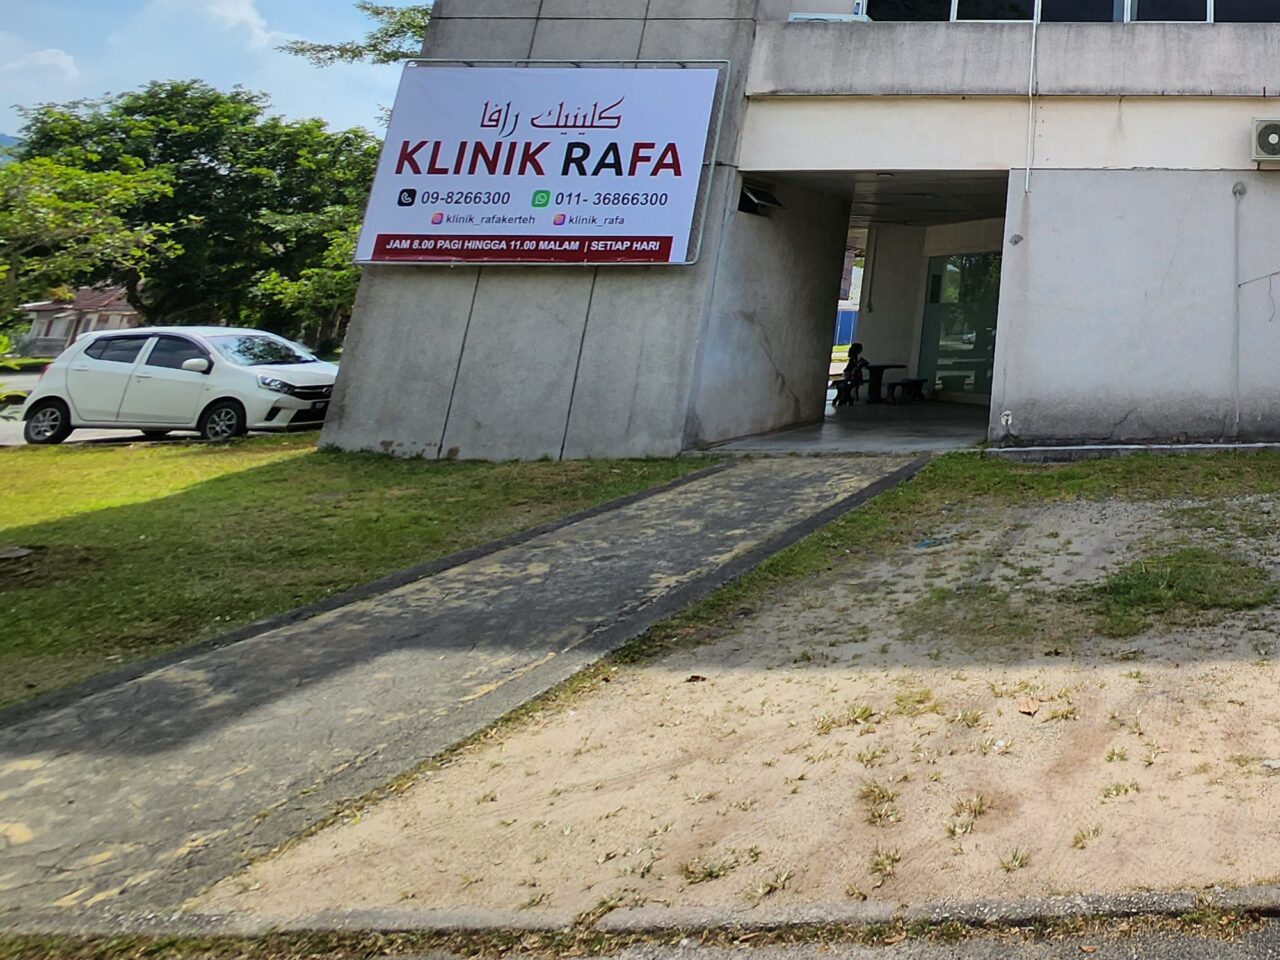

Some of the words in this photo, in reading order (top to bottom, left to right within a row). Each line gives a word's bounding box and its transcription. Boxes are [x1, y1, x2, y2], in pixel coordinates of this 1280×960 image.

[394, 140, 552, 176] KLINIK
[560, 142, 683, 177] RAFA
[421, 191, 511, 205] 09-8266300
[446, 214, 536, 226] klinik_rafakerteh
[568, 214, 625, 227] klinik_rafa
[386, 239, 410, 249] JAM
[412, 239, 435, 250] 8.00
[436, 240, 461, 250] PAGI
[463, 240, 507, 250] HINGGA
[509, 240, 536, 250] 11.00
[538, 241, 579, 251] MALAM
[590, 241, 630, 251] SETIAP
[632, 242, 660, 251] HARI
